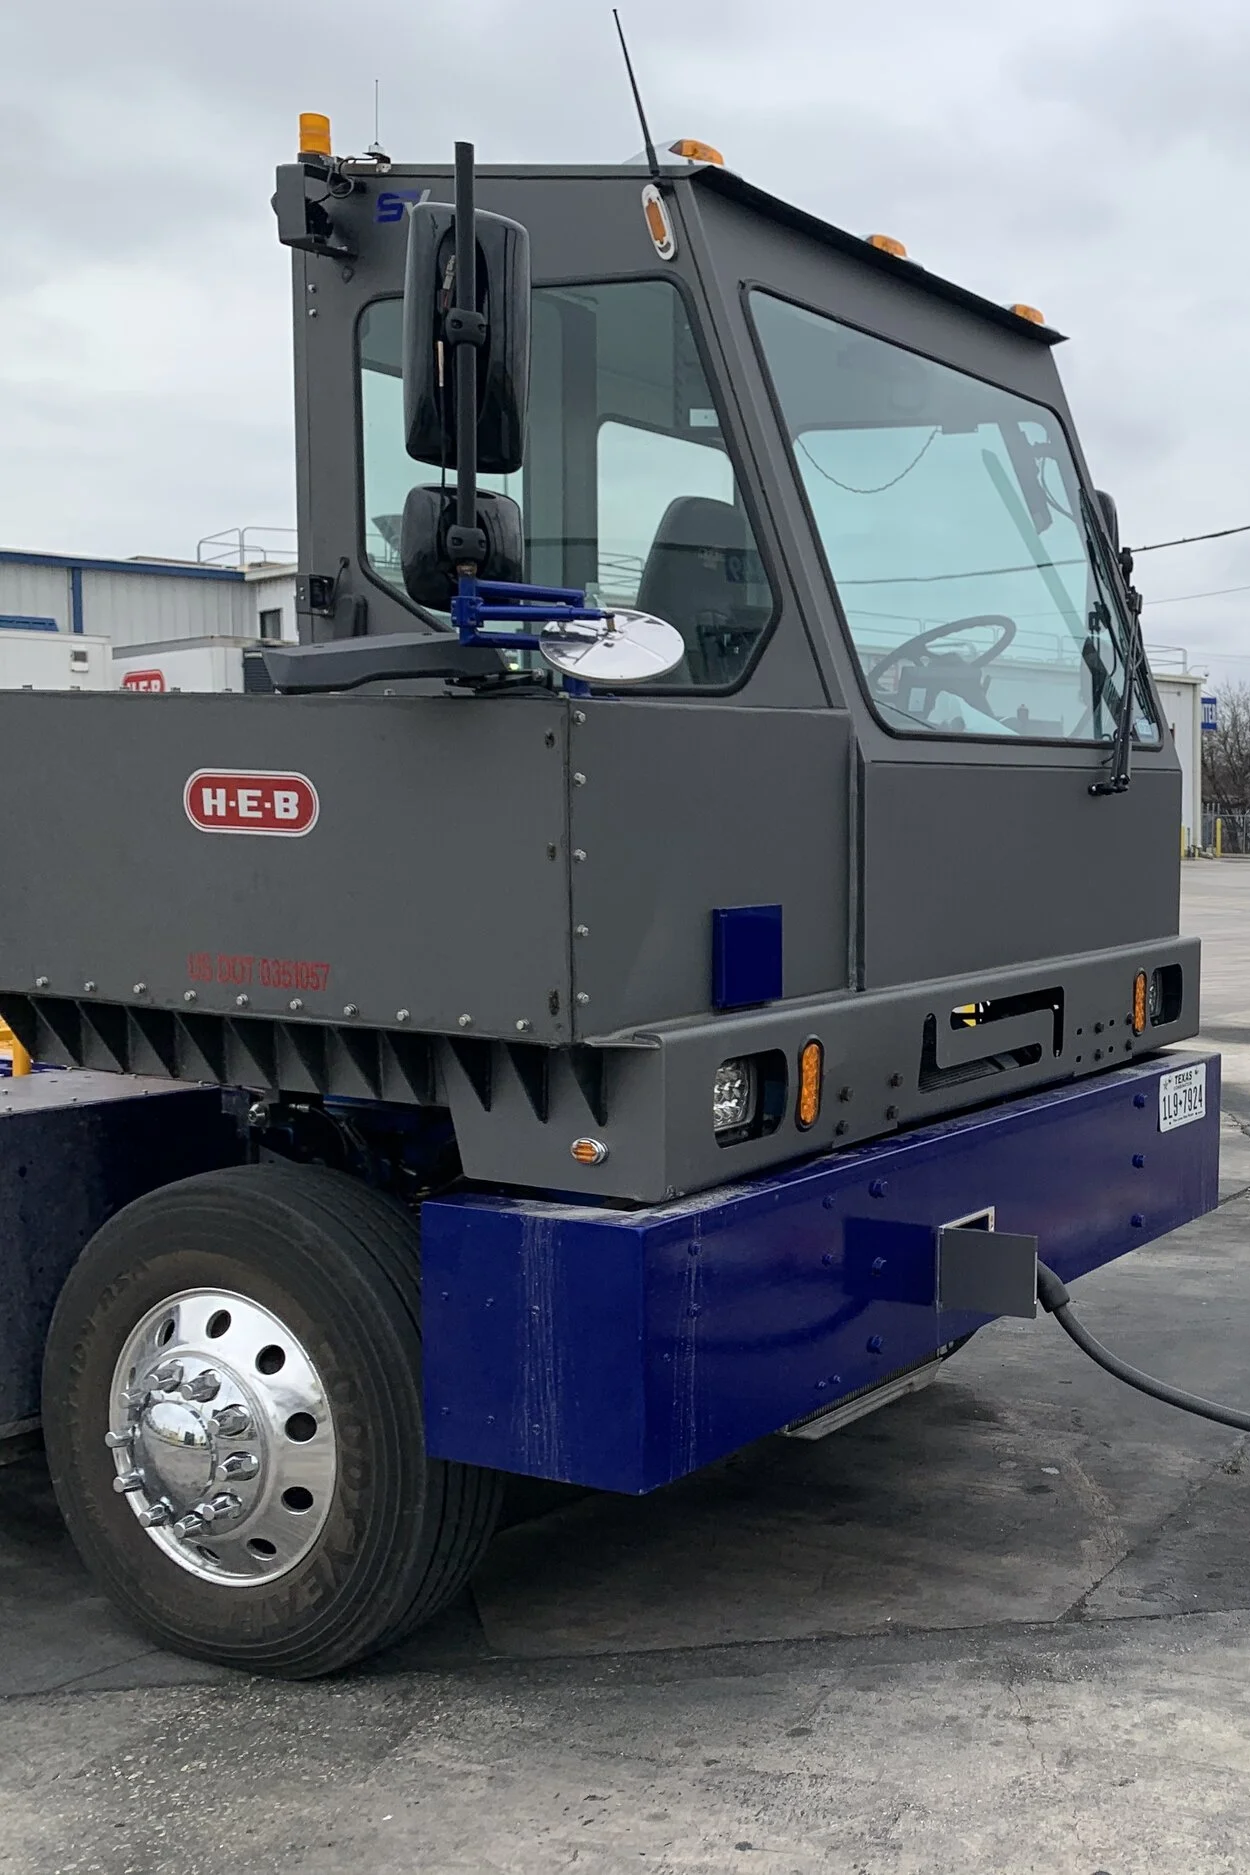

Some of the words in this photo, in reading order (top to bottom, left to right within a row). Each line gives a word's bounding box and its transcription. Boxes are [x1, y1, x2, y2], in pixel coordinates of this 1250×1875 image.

[187, 952, 213, 983] US
[217, 954, 256, 986] DOT
[1174, 1070, 1193, 1085] TEXAS
